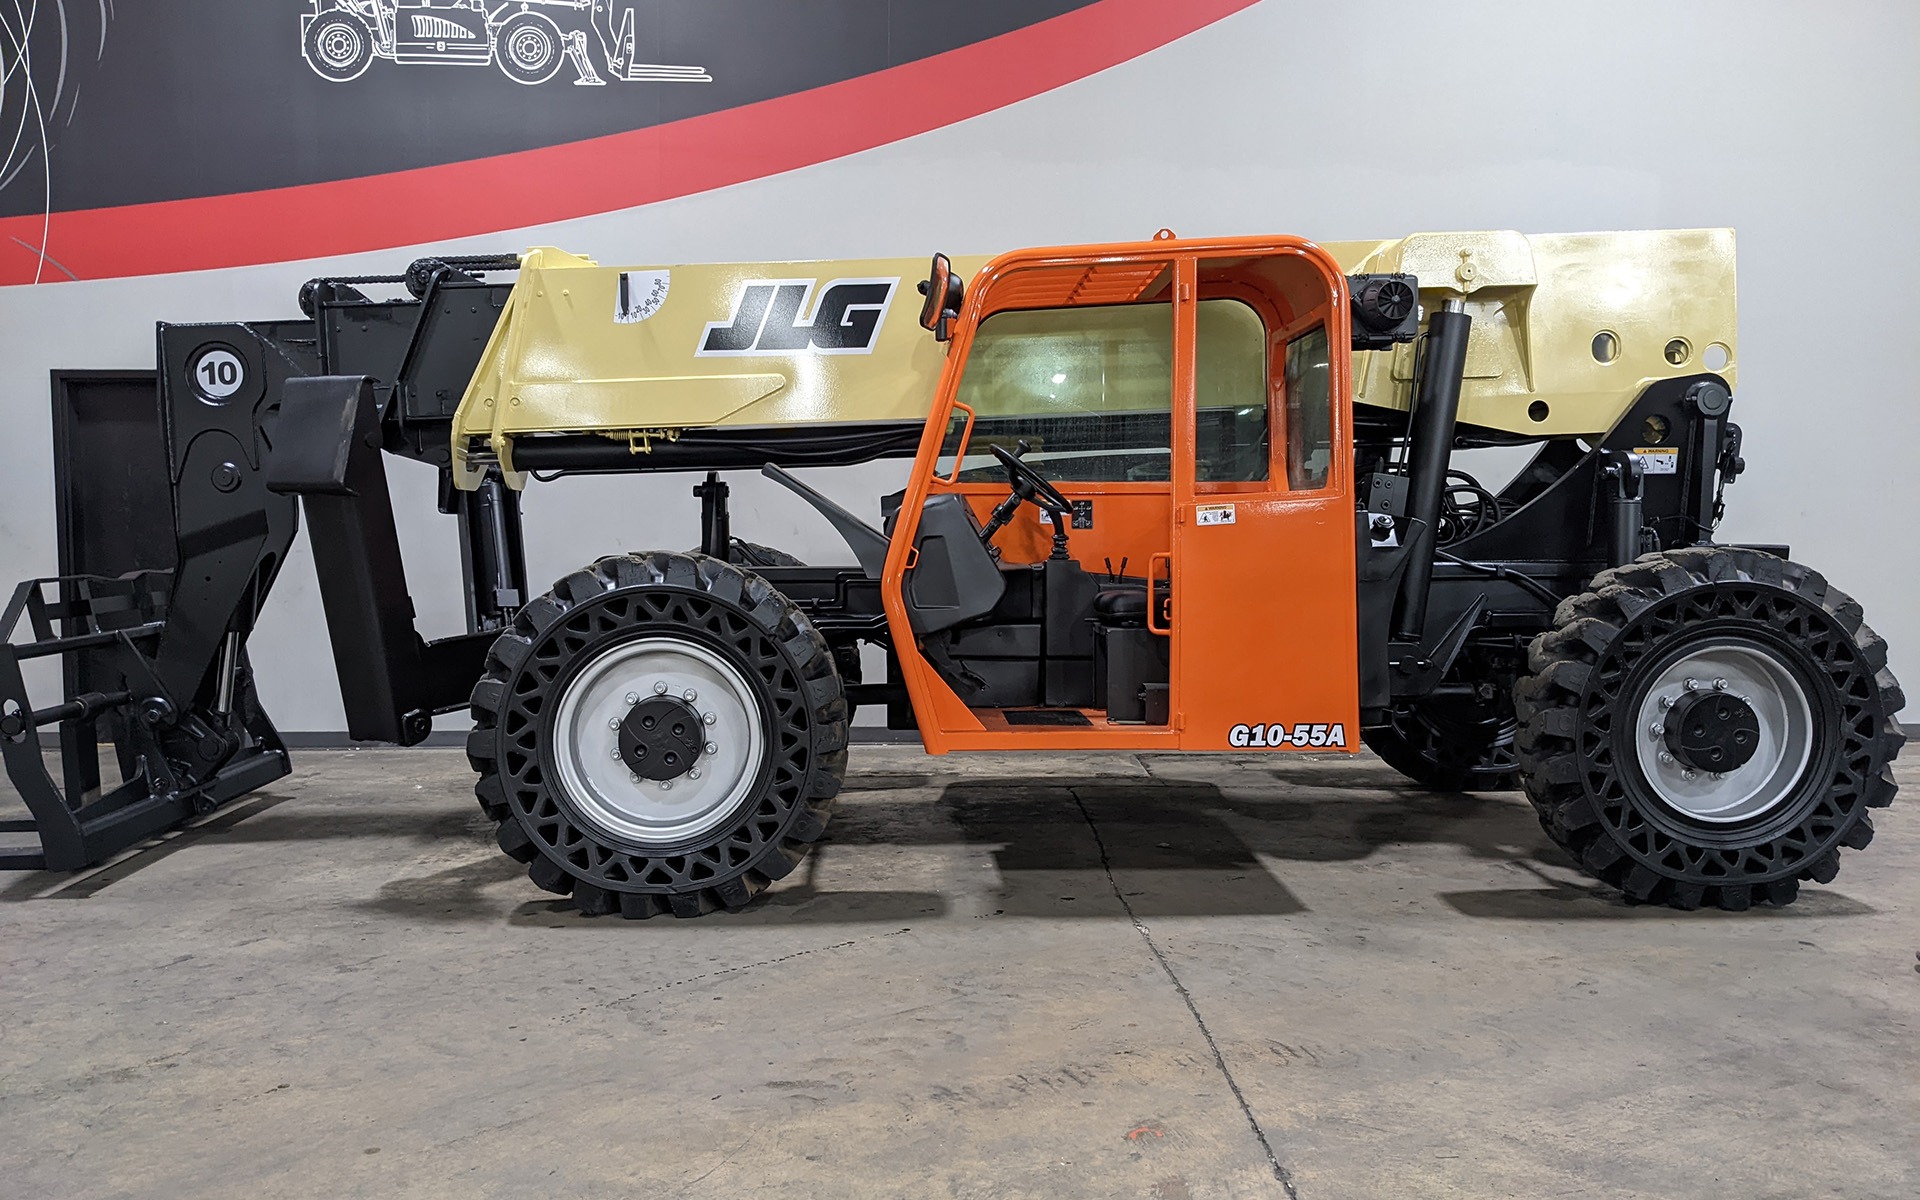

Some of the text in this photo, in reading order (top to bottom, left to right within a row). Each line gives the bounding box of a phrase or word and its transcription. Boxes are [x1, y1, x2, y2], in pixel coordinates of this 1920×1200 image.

[635, 305, 642, 313] 20
[702, 282, 893, 351] JLG
[201, 361, 238, 386] 10
[1228, 723, 1346, 748] G10-55A
